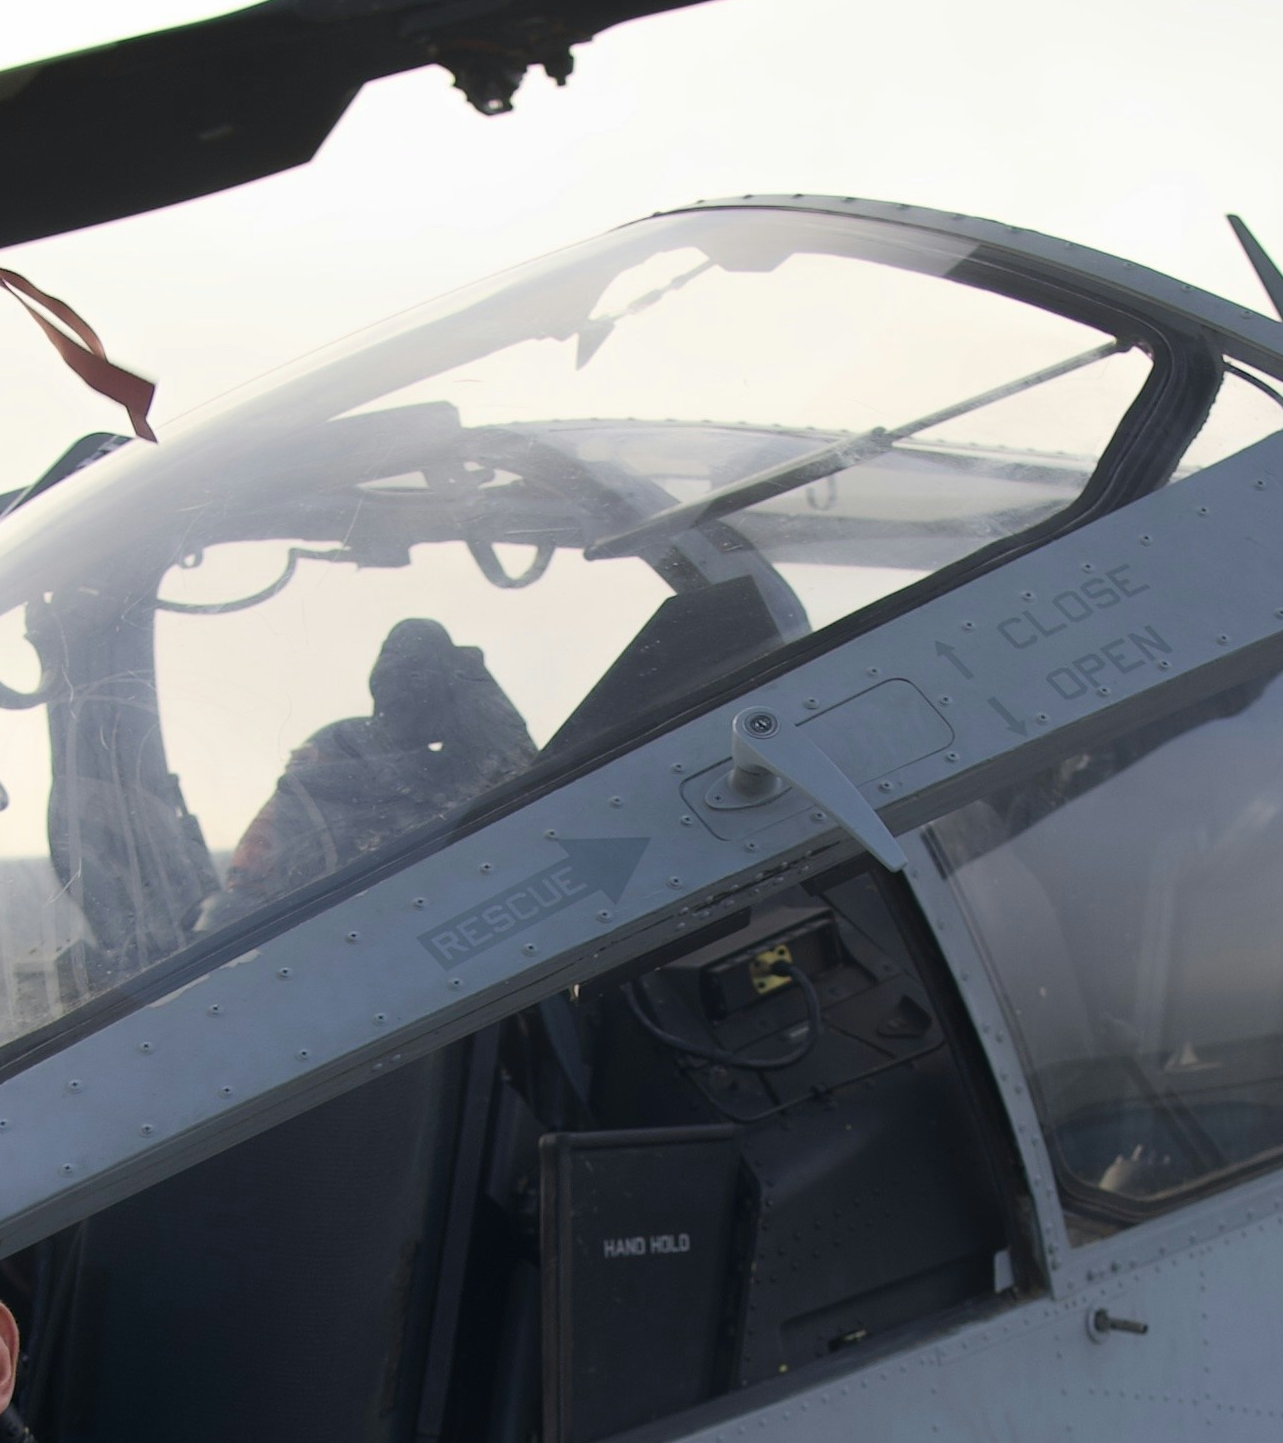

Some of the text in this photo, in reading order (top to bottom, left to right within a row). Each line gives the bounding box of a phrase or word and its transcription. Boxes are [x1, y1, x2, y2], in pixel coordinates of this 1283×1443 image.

[996, 563, 1151, 650] CLOSE
[1045, 625, 1174, 700] OPEN
[430, 865, 589, 960] RESCUE
[603, 1233, 691, 1258] HAND HOLD
